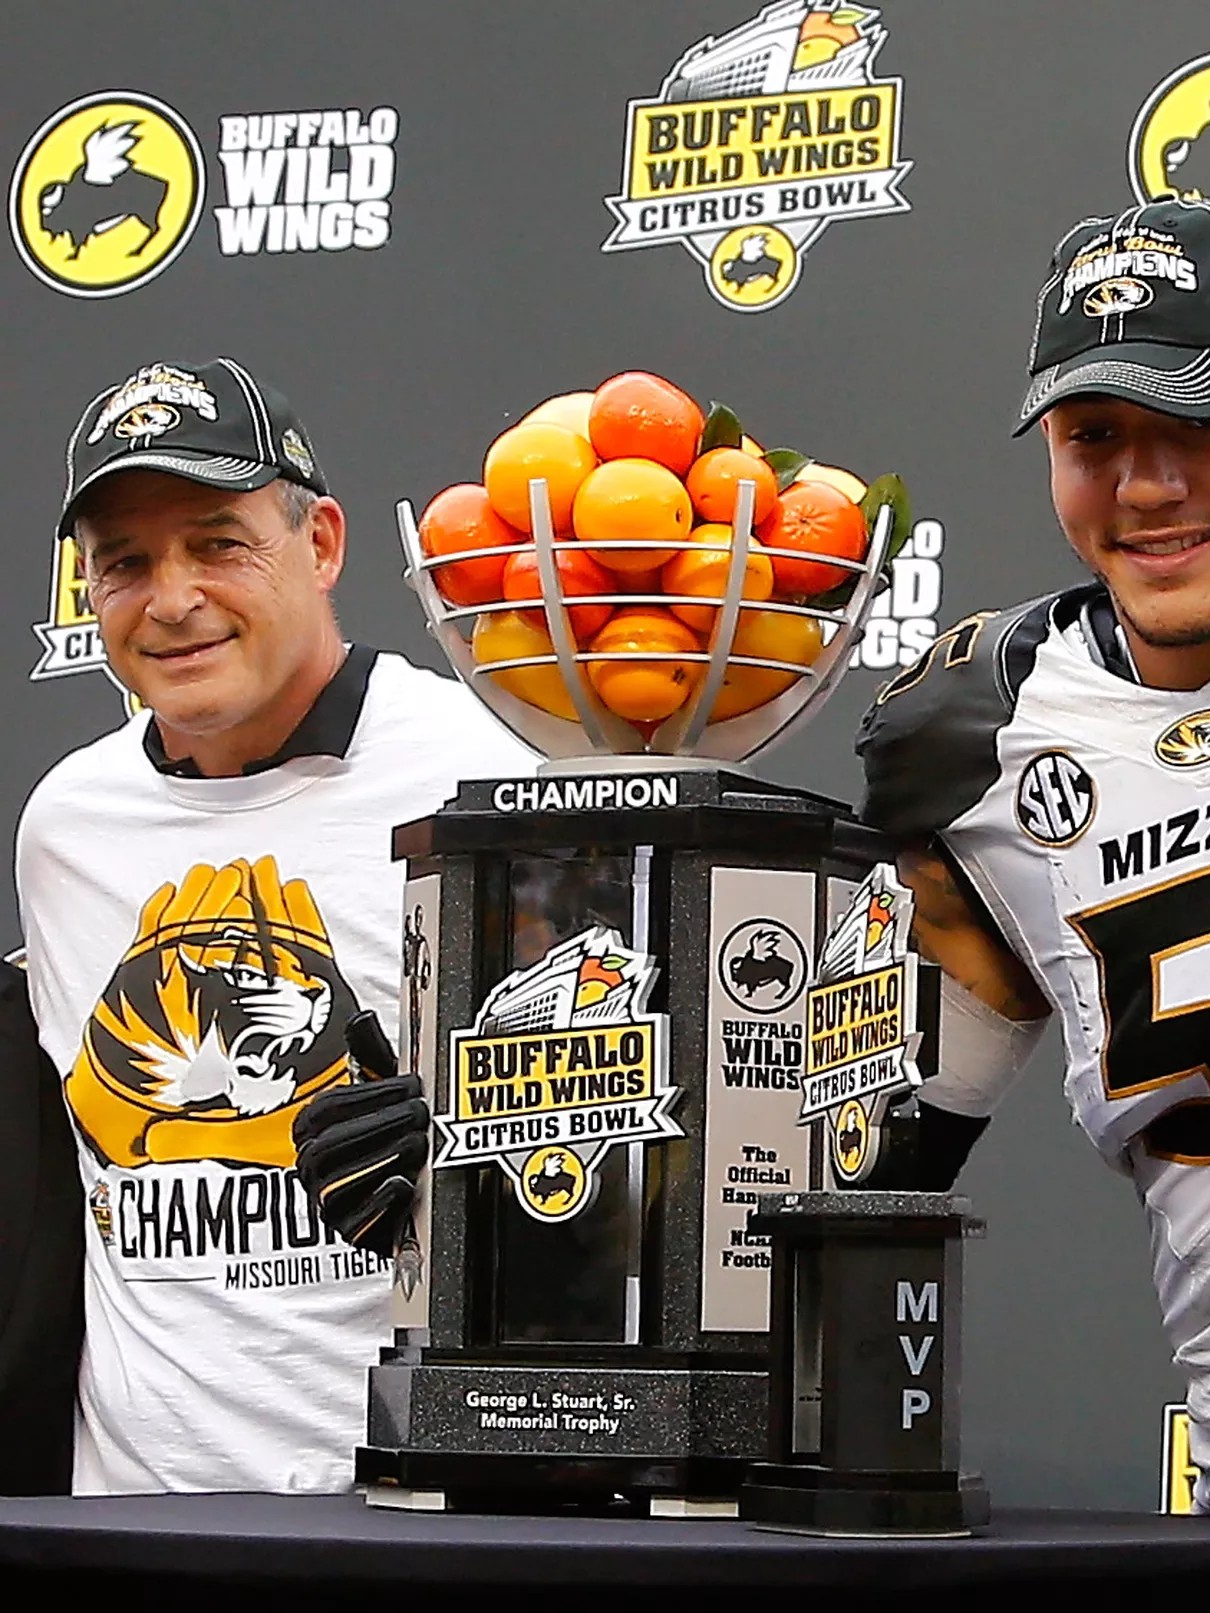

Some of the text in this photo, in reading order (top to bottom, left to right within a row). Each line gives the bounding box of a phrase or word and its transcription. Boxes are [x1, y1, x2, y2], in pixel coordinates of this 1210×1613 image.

[221, 109, 396, 152] BUFFALO
[648, 95, 881, 155] BUFFALO
[219, 146, 394, 205] WILD
[645, 137, 880, 191] WILD WINGS
[215, 202, 391, 255] WINGS
[638, 180, 876, 232] CITRUS BOWL
[494, 777, 677, 812] CHAMPION
[1021, 755, 1090, 839] SEC
[811, 971, 899, 1036] BUFFALO
[721, 1020, 802, 1039] BUFFALO
[811, 1013, 899, 1070] WILD WINGS
[466, 1030, 644, 1083] BUFFALO
[722, 1038, 802, 1067] WILD
[467, 1068, 645, 1115] WILD WINGS
[721, 1065, 800, 1090] WINGS
[809, 1055, 896, 1106] CITRUS BOWL
[465, 1106, 645, 1150] CITRUS BOWL
[727, 1166, 791, 1185] Official
[742, 1145, 777, 1163] The
[119, 1168, 344, 1258] CHAMPIO
[722, 1187, 757, 1204] Han
[225, 1257, 321, 1290] MISSOURI
[722, 1250, 771, 1268] Footb
[896, 1281, 938, 1430] MVP
[466, 1391, 636, 1412] George L. Stuart, Sr.
[480, 1412, 620, 1435] Memorial Trophy
